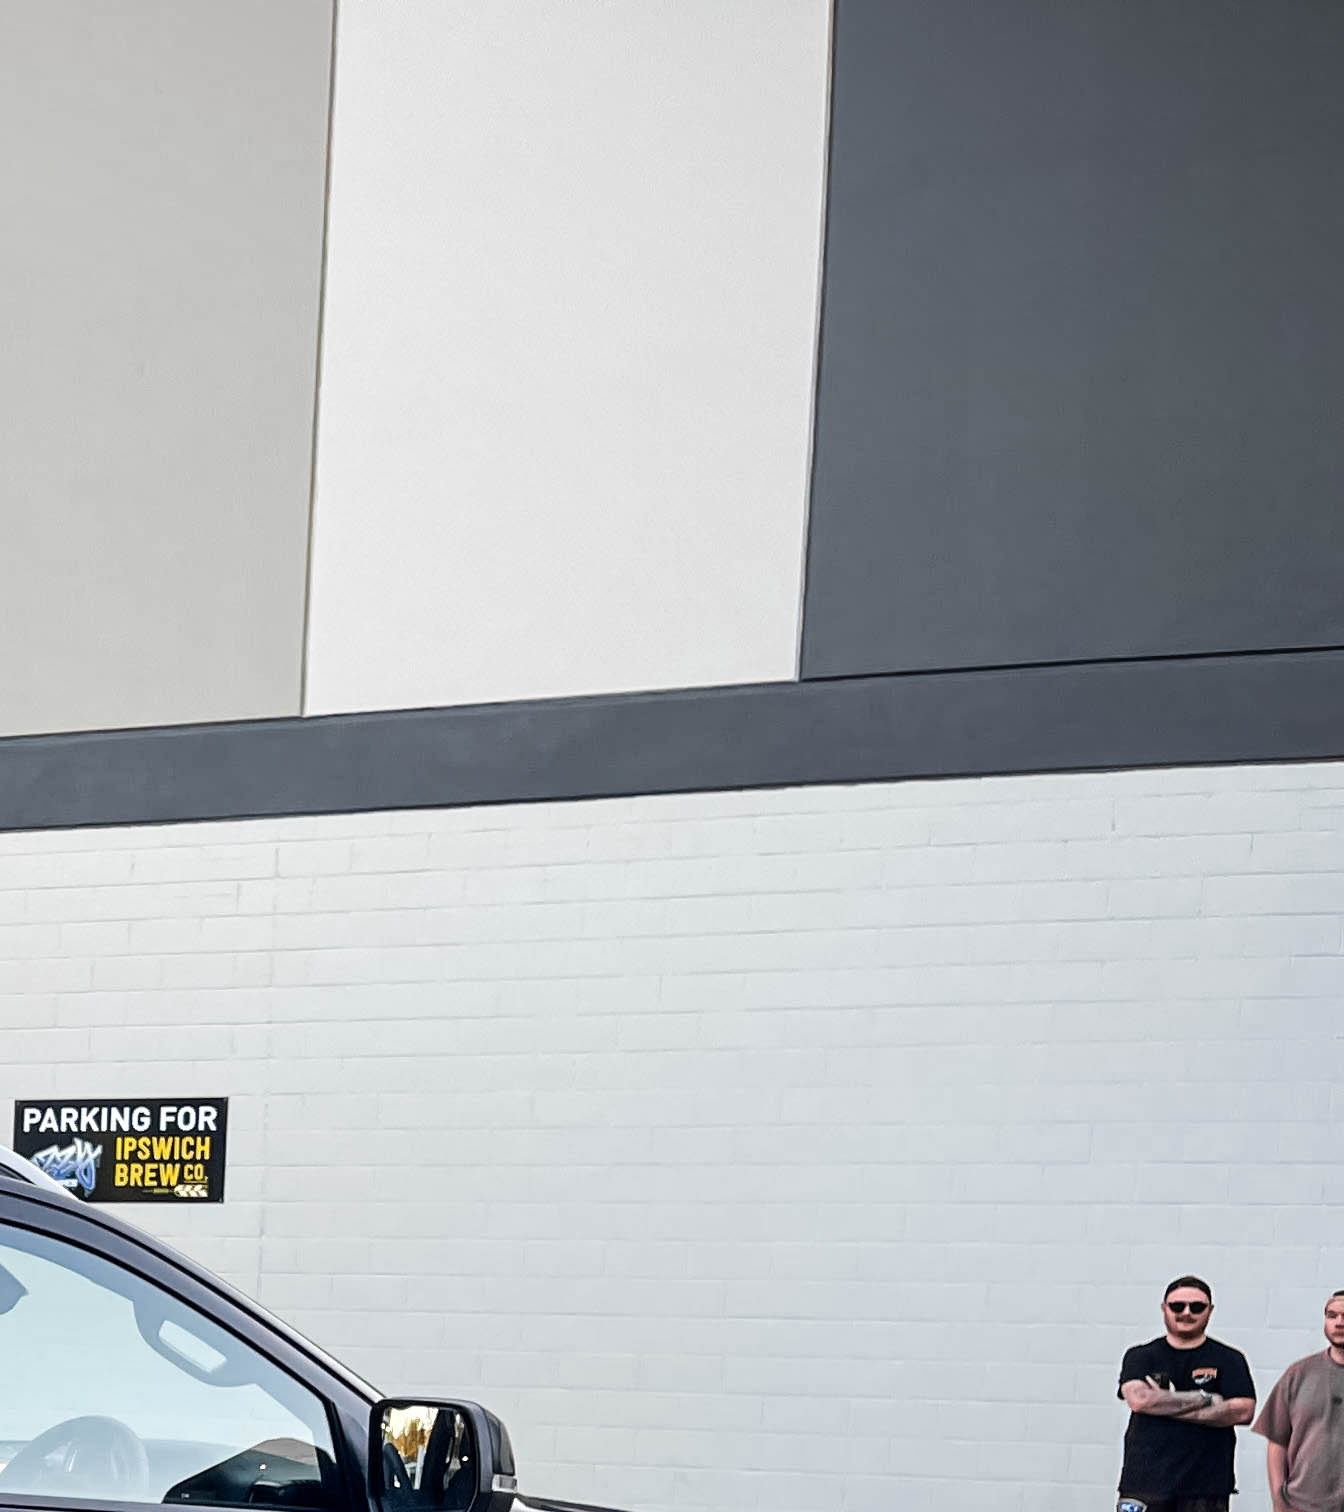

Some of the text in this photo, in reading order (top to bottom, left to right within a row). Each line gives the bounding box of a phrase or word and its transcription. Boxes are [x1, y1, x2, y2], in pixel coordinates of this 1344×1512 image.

[22, 1105, 218, 1132] PARKING FOR
[115, 1136, 211, 1161] IPSWICH
[114, 1163, 180, 1187] BREW
